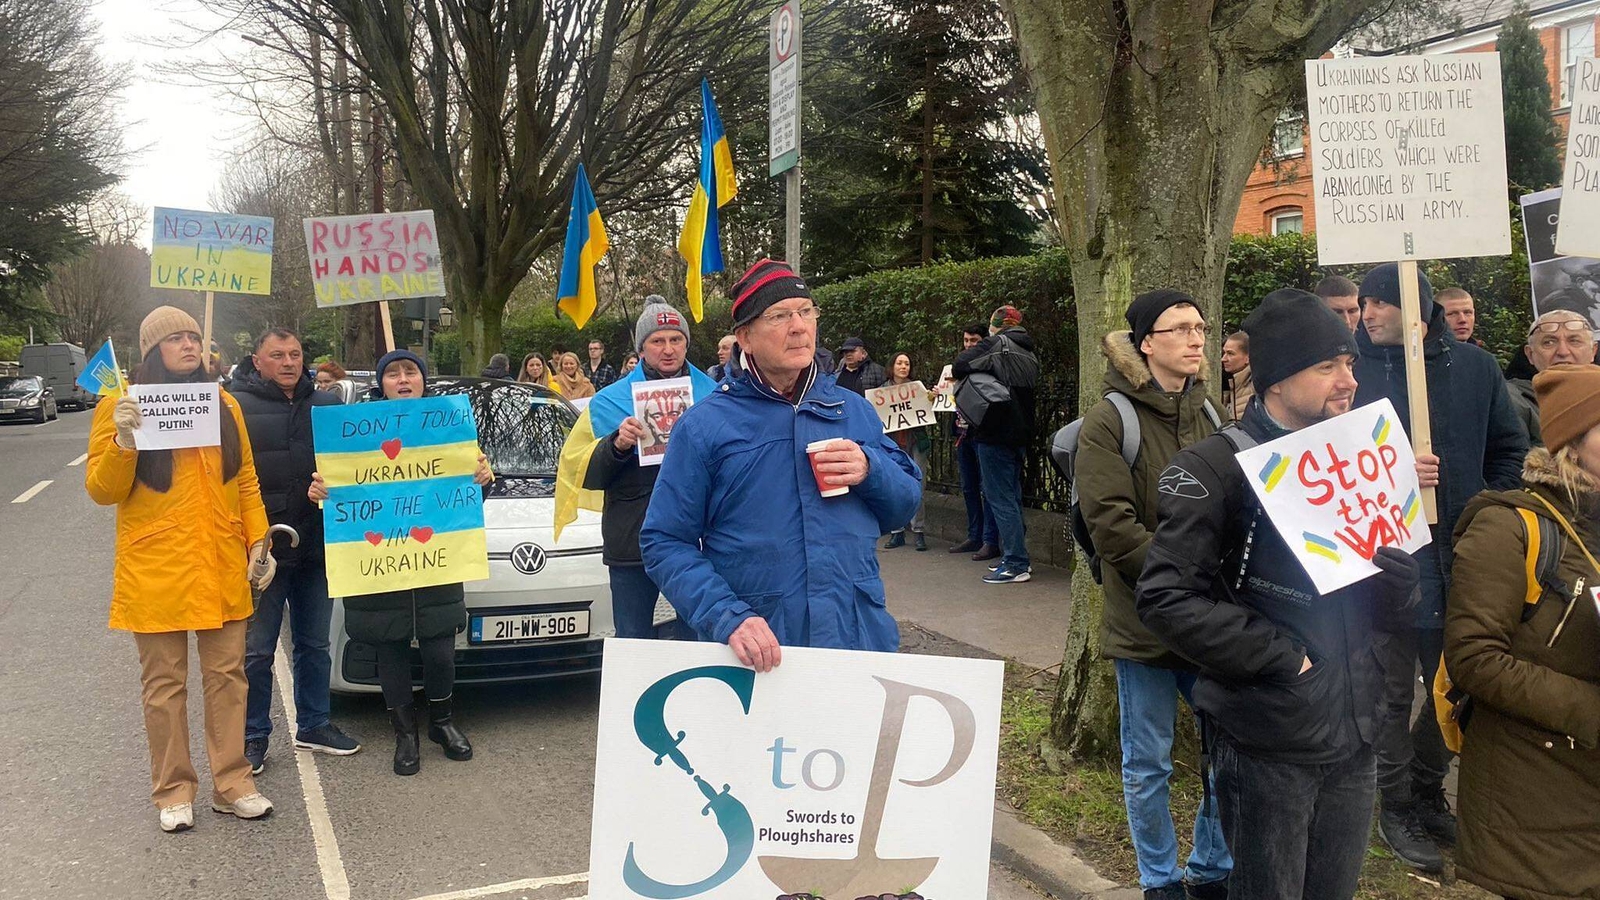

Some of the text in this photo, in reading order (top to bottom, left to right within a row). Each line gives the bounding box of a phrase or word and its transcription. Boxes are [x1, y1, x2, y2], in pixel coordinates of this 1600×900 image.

[1396, 65, 1419, 84] ASK
[1319, 89, 1473, 115] MOTHERS TO RETURN THE
[1319, 121, 1377, 143] CORPSES
[1385, 119, 1402, 139] OF
[1394, 145, 1436, 167] WHICH
[1443, 145, 1481, 164] WERE
[1401, 173, 1416, 194] BY
[1426, 171, 1453, 192] THE
[164, 215, 268, 246] NO WAR
[312, 217, 433, 255] RUSSIA
[196, 243, 224, 265] IN
[314, 252, 428, 280] HANDS
[157, 264, 259, 292] UKRAINE
[315, 271, 440, 305] UKRAINE
[138, 392, 212, 404] HAAG WILL BE
[874, 383, 920, 406] STOP
[141, 406, 209, 417] CALLING FOR
[889, 401, 912, 413] THE
[158, 420, 193, 430] PUTIN!
[421, 408, 472, 430] TOUCH
[355, 458, 446, 485] UKRAINE
[335, 486, 477, 523] STOP THE WAR
[1336, 491, 1389, 525] the
[386, 527, 411, 547] IN
[1334, 504, 1412, 561] WAR
[360, 548, 447, 577] UKRAINE
[1248, 576, 1314, 601] alpinestars
[495, 617, 576, 638] 211-WW-906
[785, 809, 856, 826] Swords to
[758, 827, 855, 846] Ploughshares
